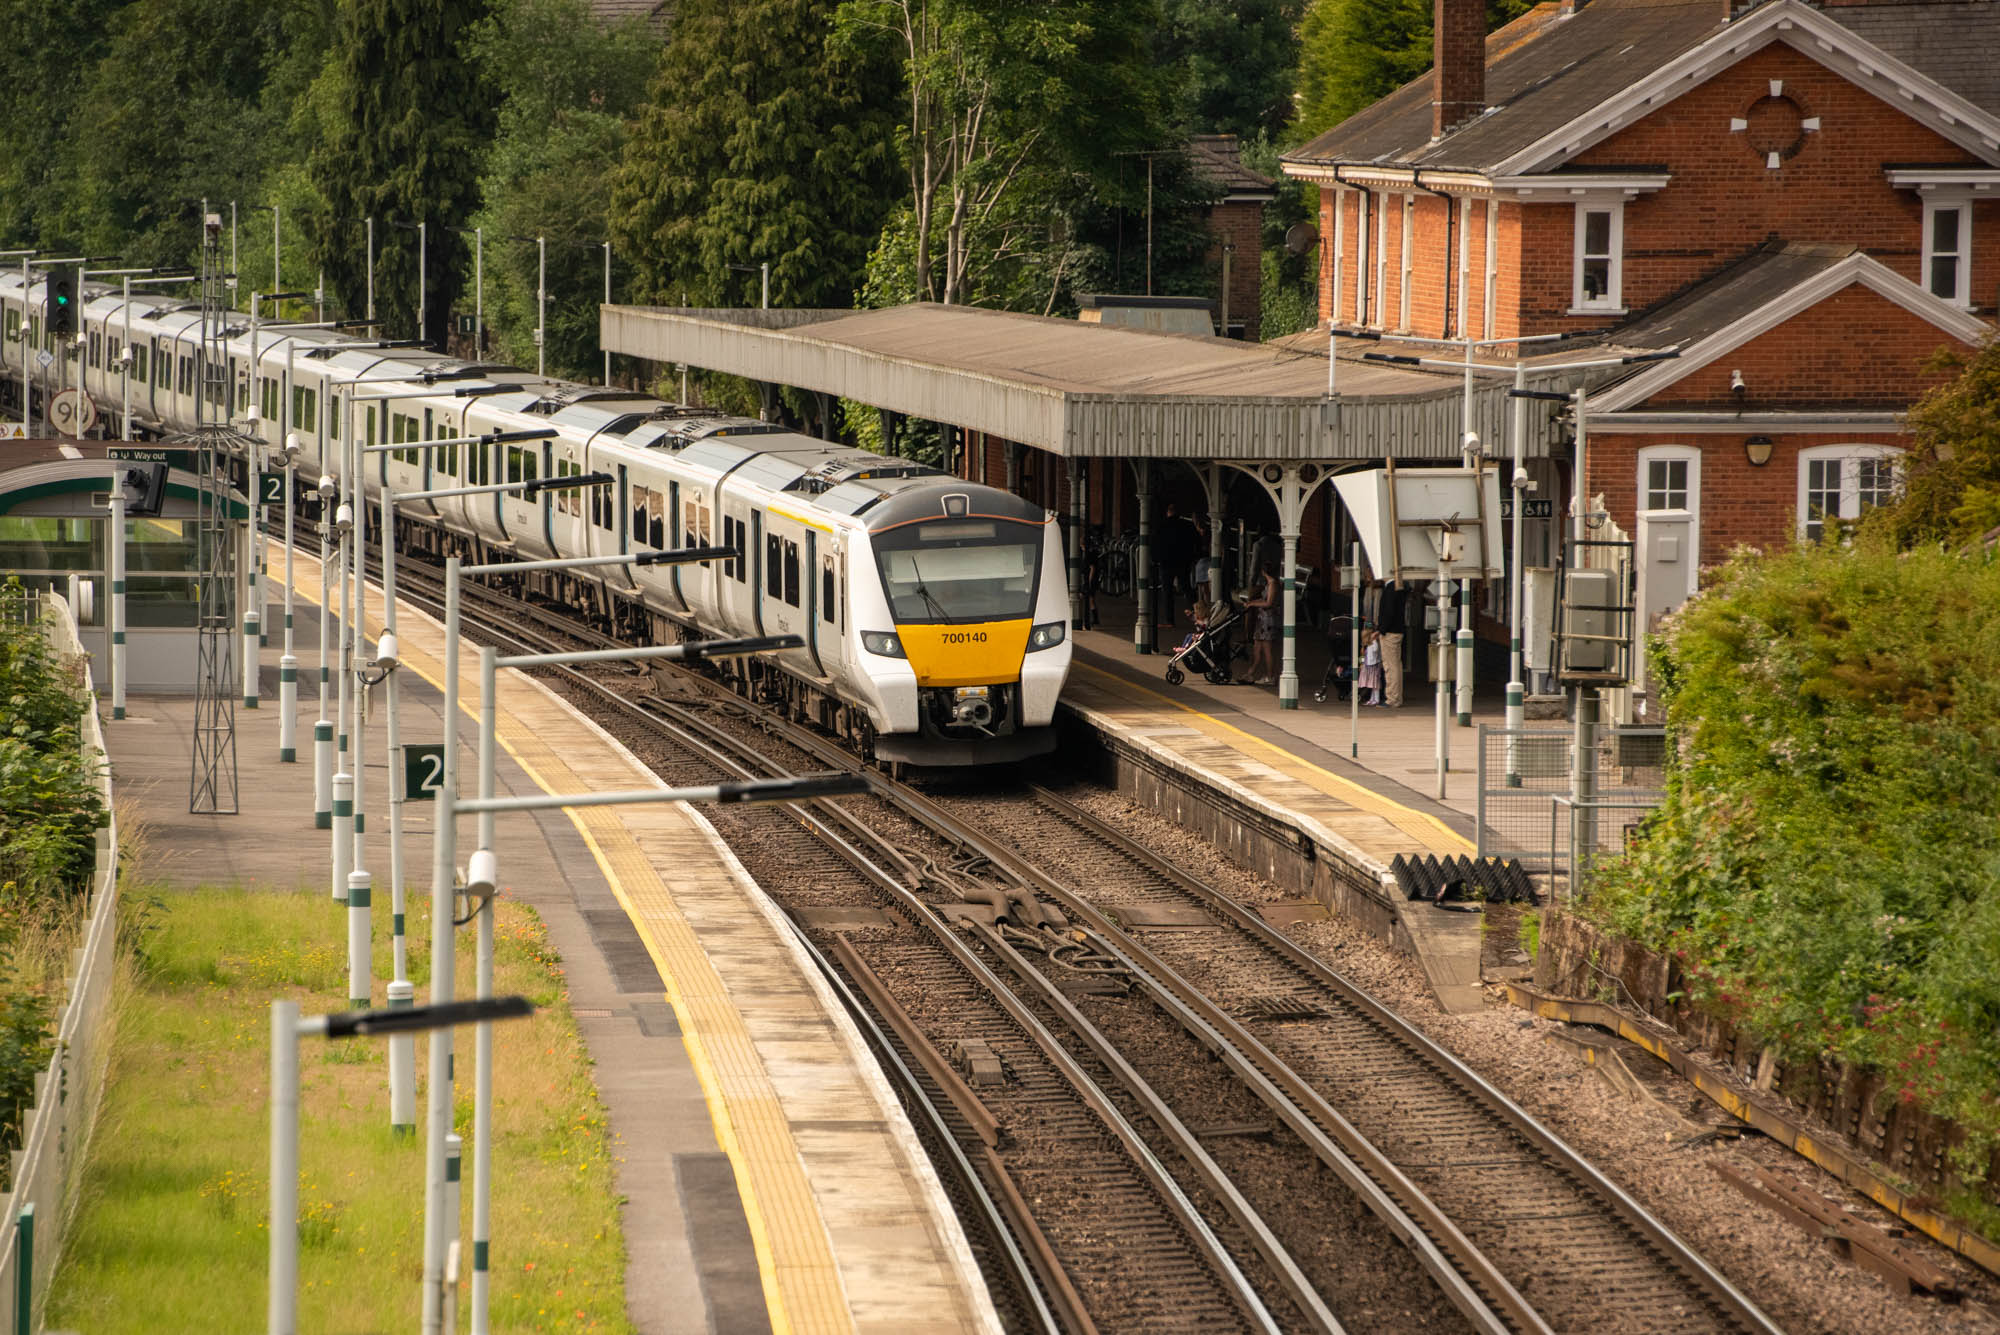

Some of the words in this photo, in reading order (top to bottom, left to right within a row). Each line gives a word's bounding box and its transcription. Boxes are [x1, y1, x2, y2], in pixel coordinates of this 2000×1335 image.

[465, 318, 470, 331] 1
[134, 450, 150, 461] Way
[152, 452, 166, 460] out
[267, 477, 281, 500] 2
[941, 632, 987, 644] 700140
[420, 753, 443, 791] 2
